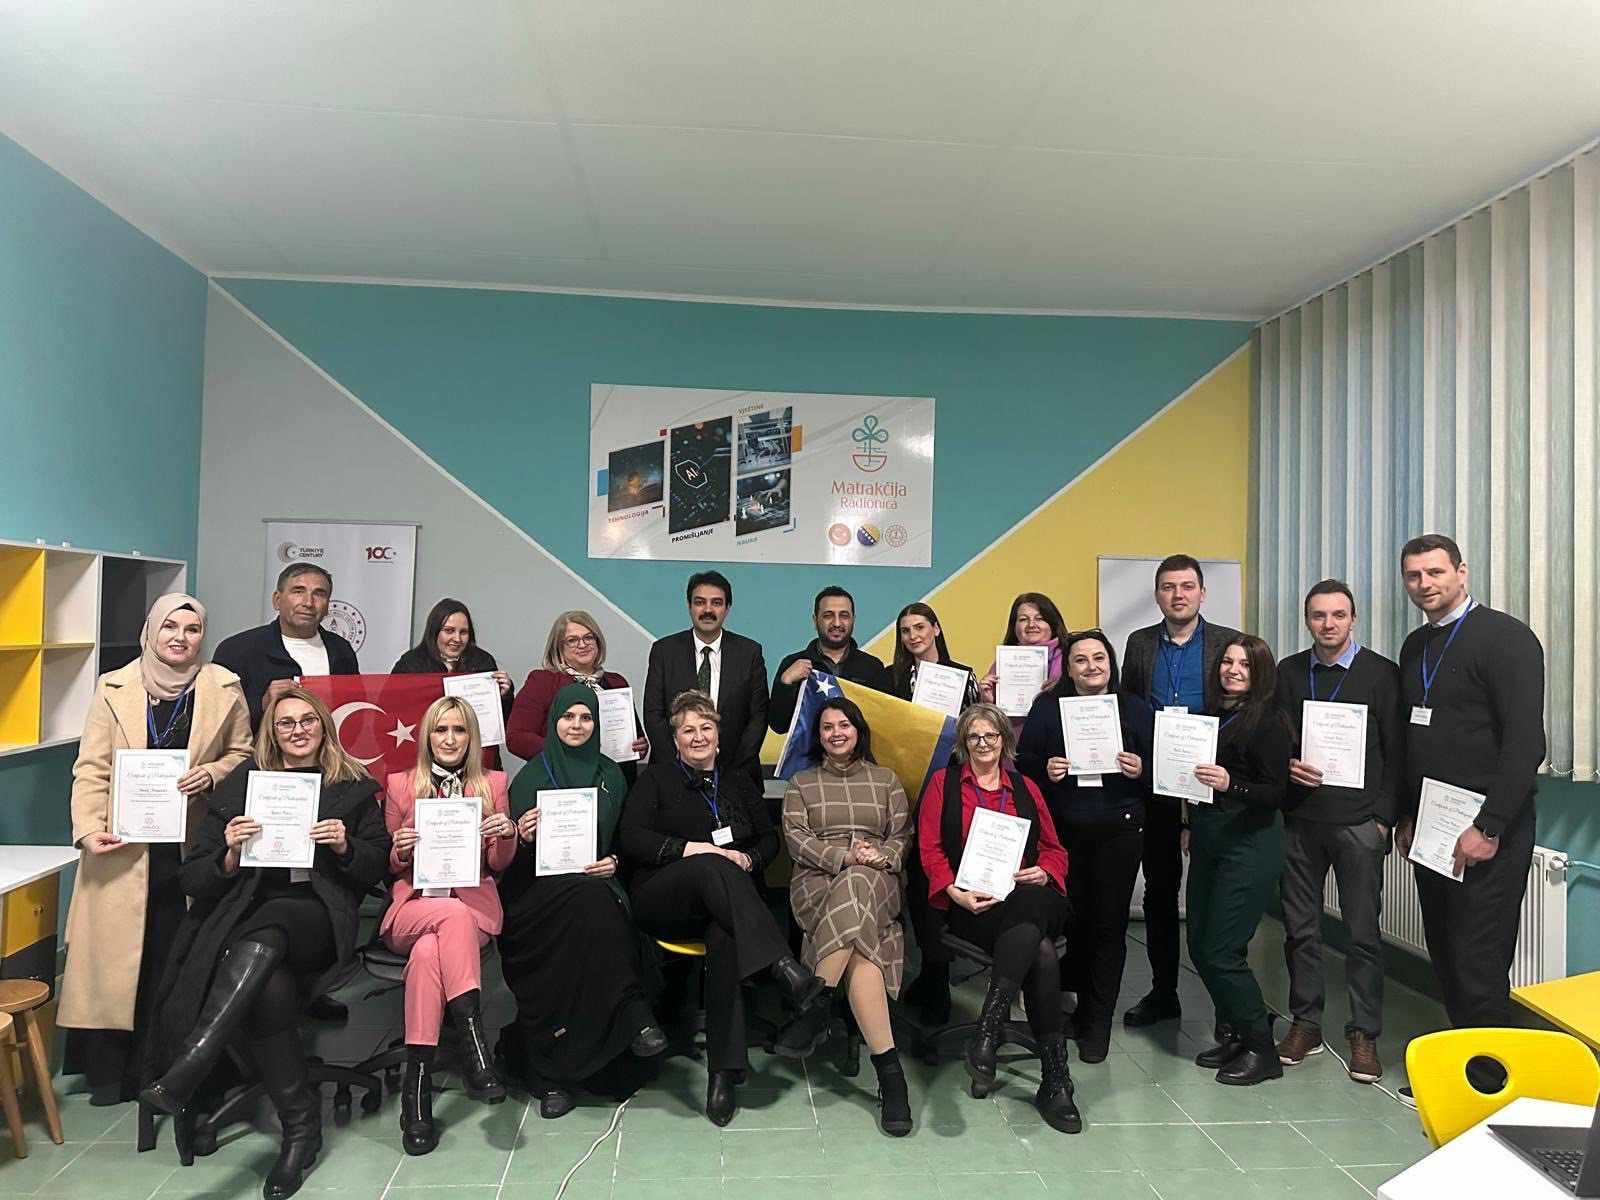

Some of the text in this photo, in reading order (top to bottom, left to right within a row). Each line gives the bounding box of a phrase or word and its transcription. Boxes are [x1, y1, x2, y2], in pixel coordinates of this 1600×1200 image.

[686, 467, 698, 480] AI
[831, 480, 907, 497] Matrakčija
[841, 496, 897, 509] Radionica
[671, 528, 713, 543] PROMIŠLJANJE
